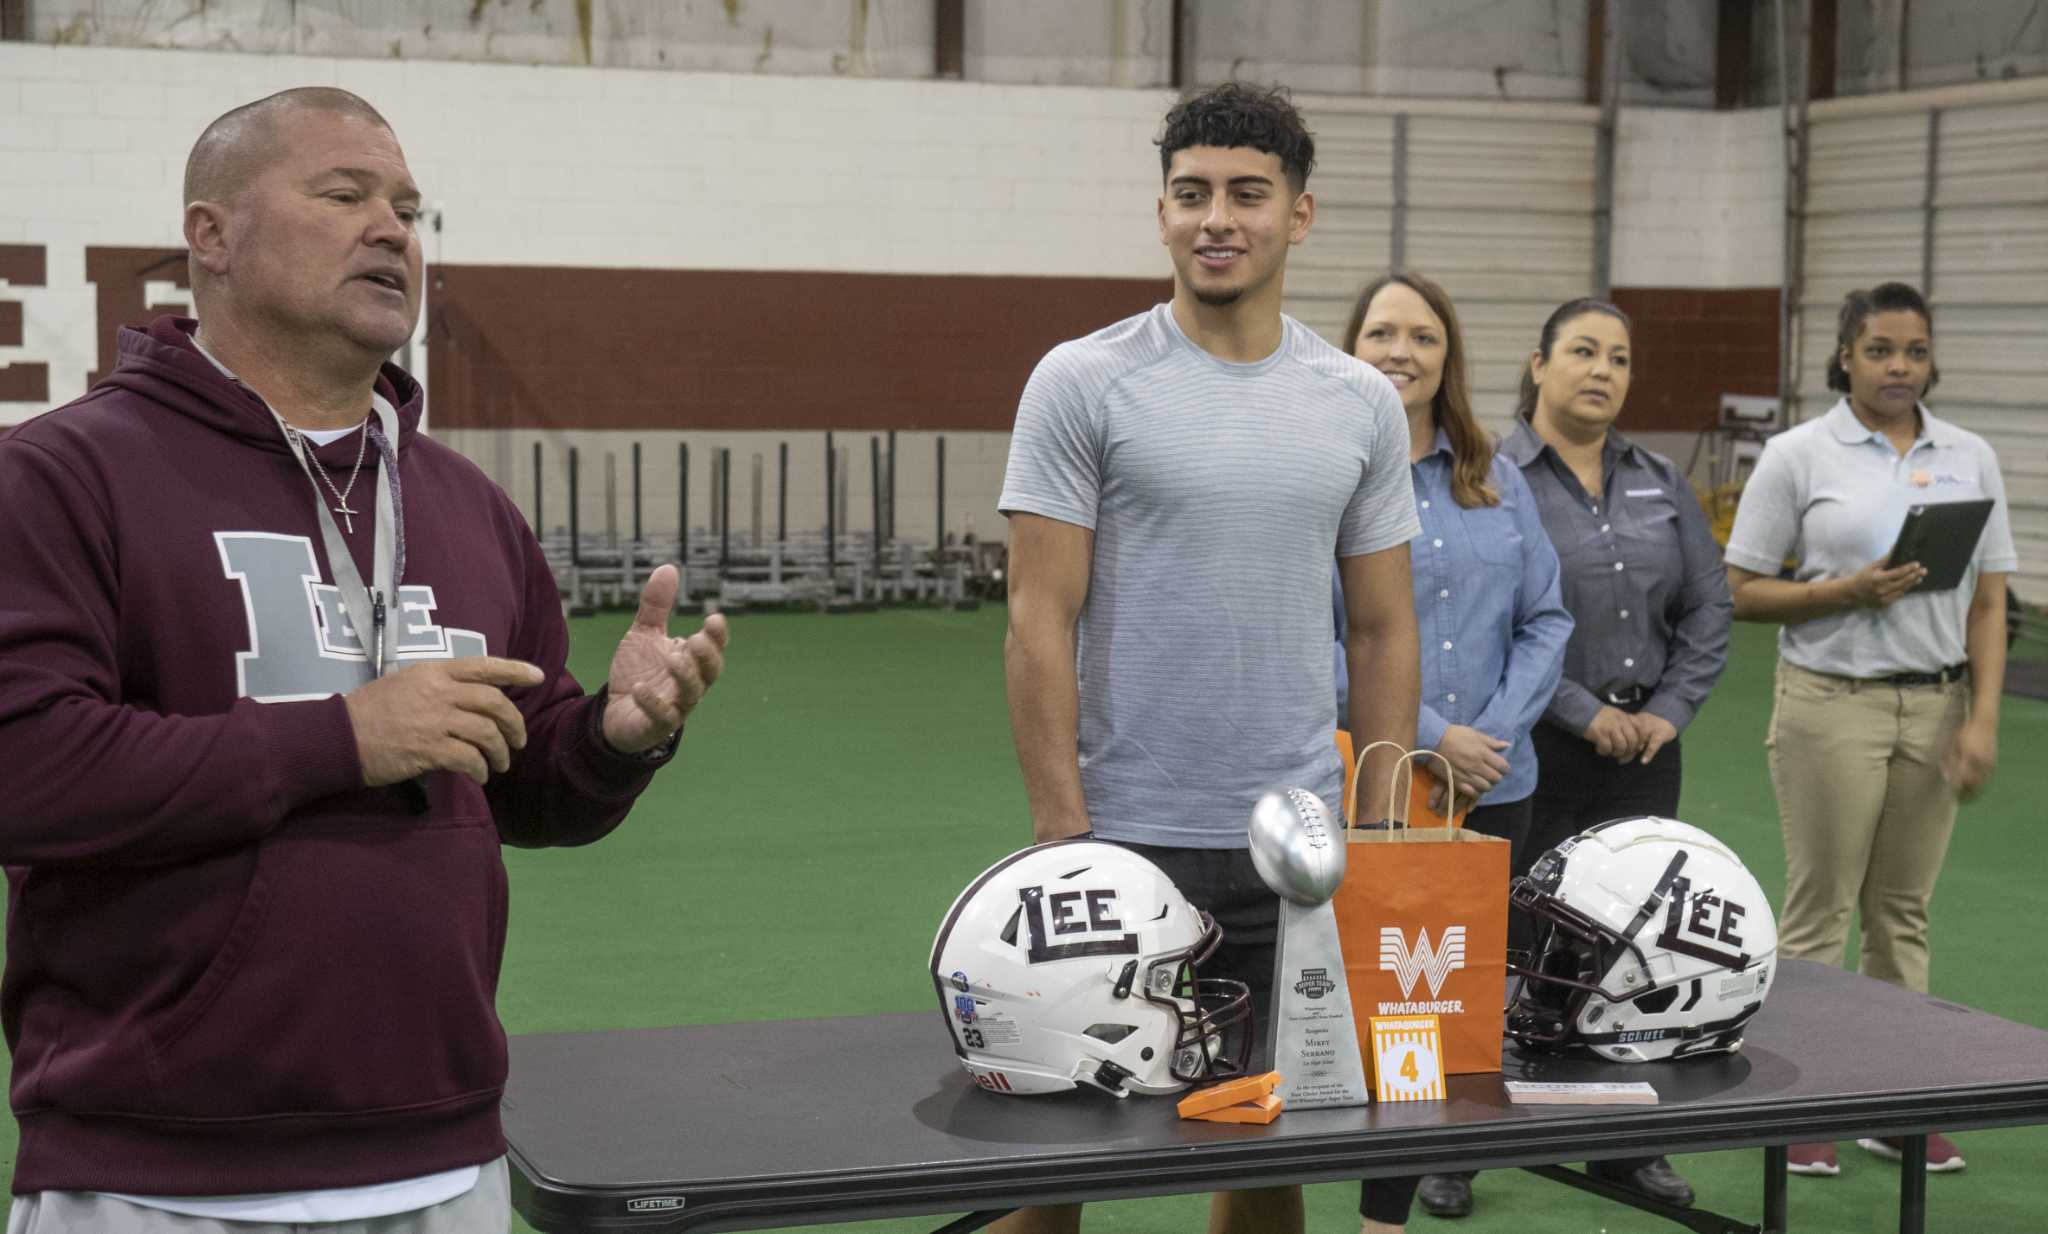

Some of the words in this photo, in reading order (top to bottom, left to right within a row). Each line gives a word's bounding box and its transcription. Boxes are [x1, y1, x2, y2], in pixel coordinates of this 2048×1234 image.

[1018, 885, 1140, 965] LEE
[1656, 875, 1751, 972] LEE
[962, 1028, 985, 1049] 23
[1400, 1050, 1419, 1083] 4
[634, 1199, 679, 1209] LIFETIME
